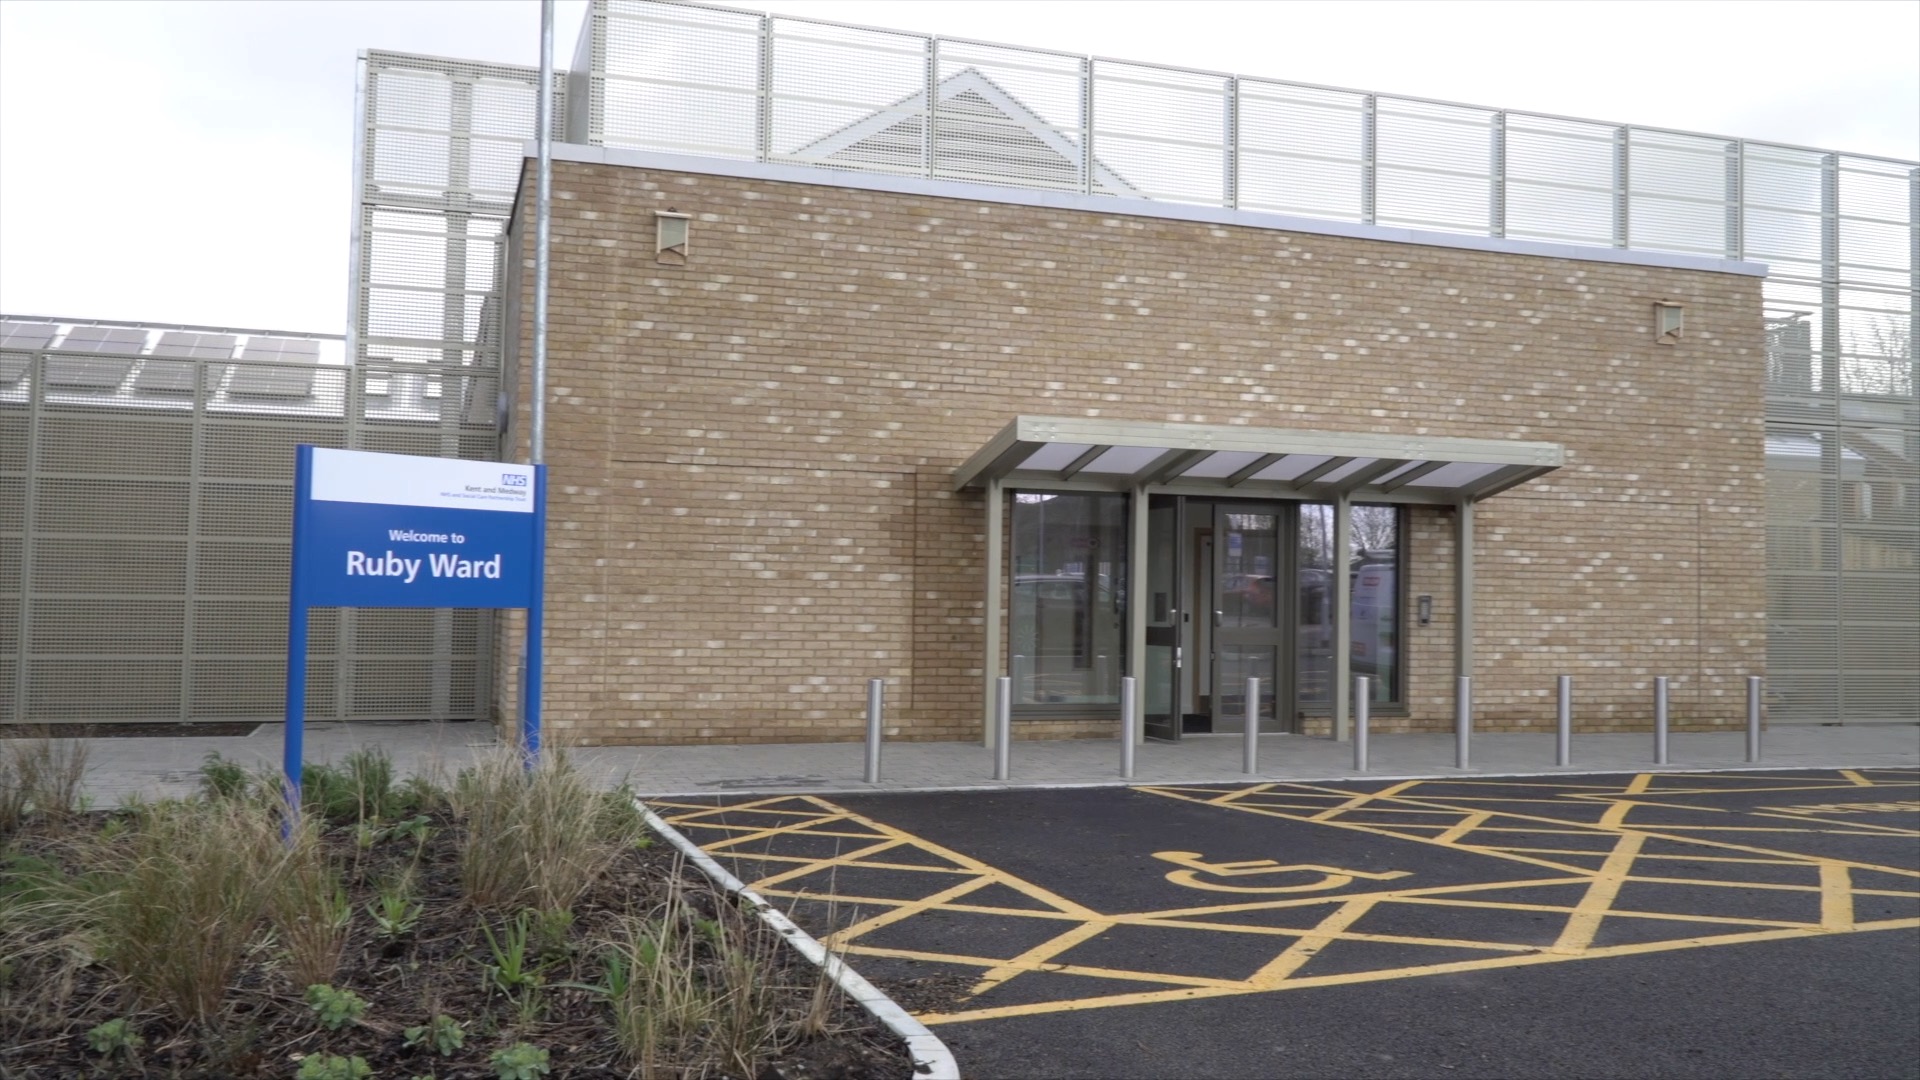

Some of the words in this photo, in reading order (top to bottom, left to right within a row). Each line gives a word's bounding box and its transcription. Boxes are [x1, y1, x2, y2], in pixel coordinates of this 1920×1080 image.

[502, 474, 527, 486] NHS
[498, 487, 527, 497] Medway
[388, 529, 449, 543] Welcome
[451, 532, 465, 544] to
[347, 550, 421, 583] Ruby
[429, 553, 501, 579] Ward
